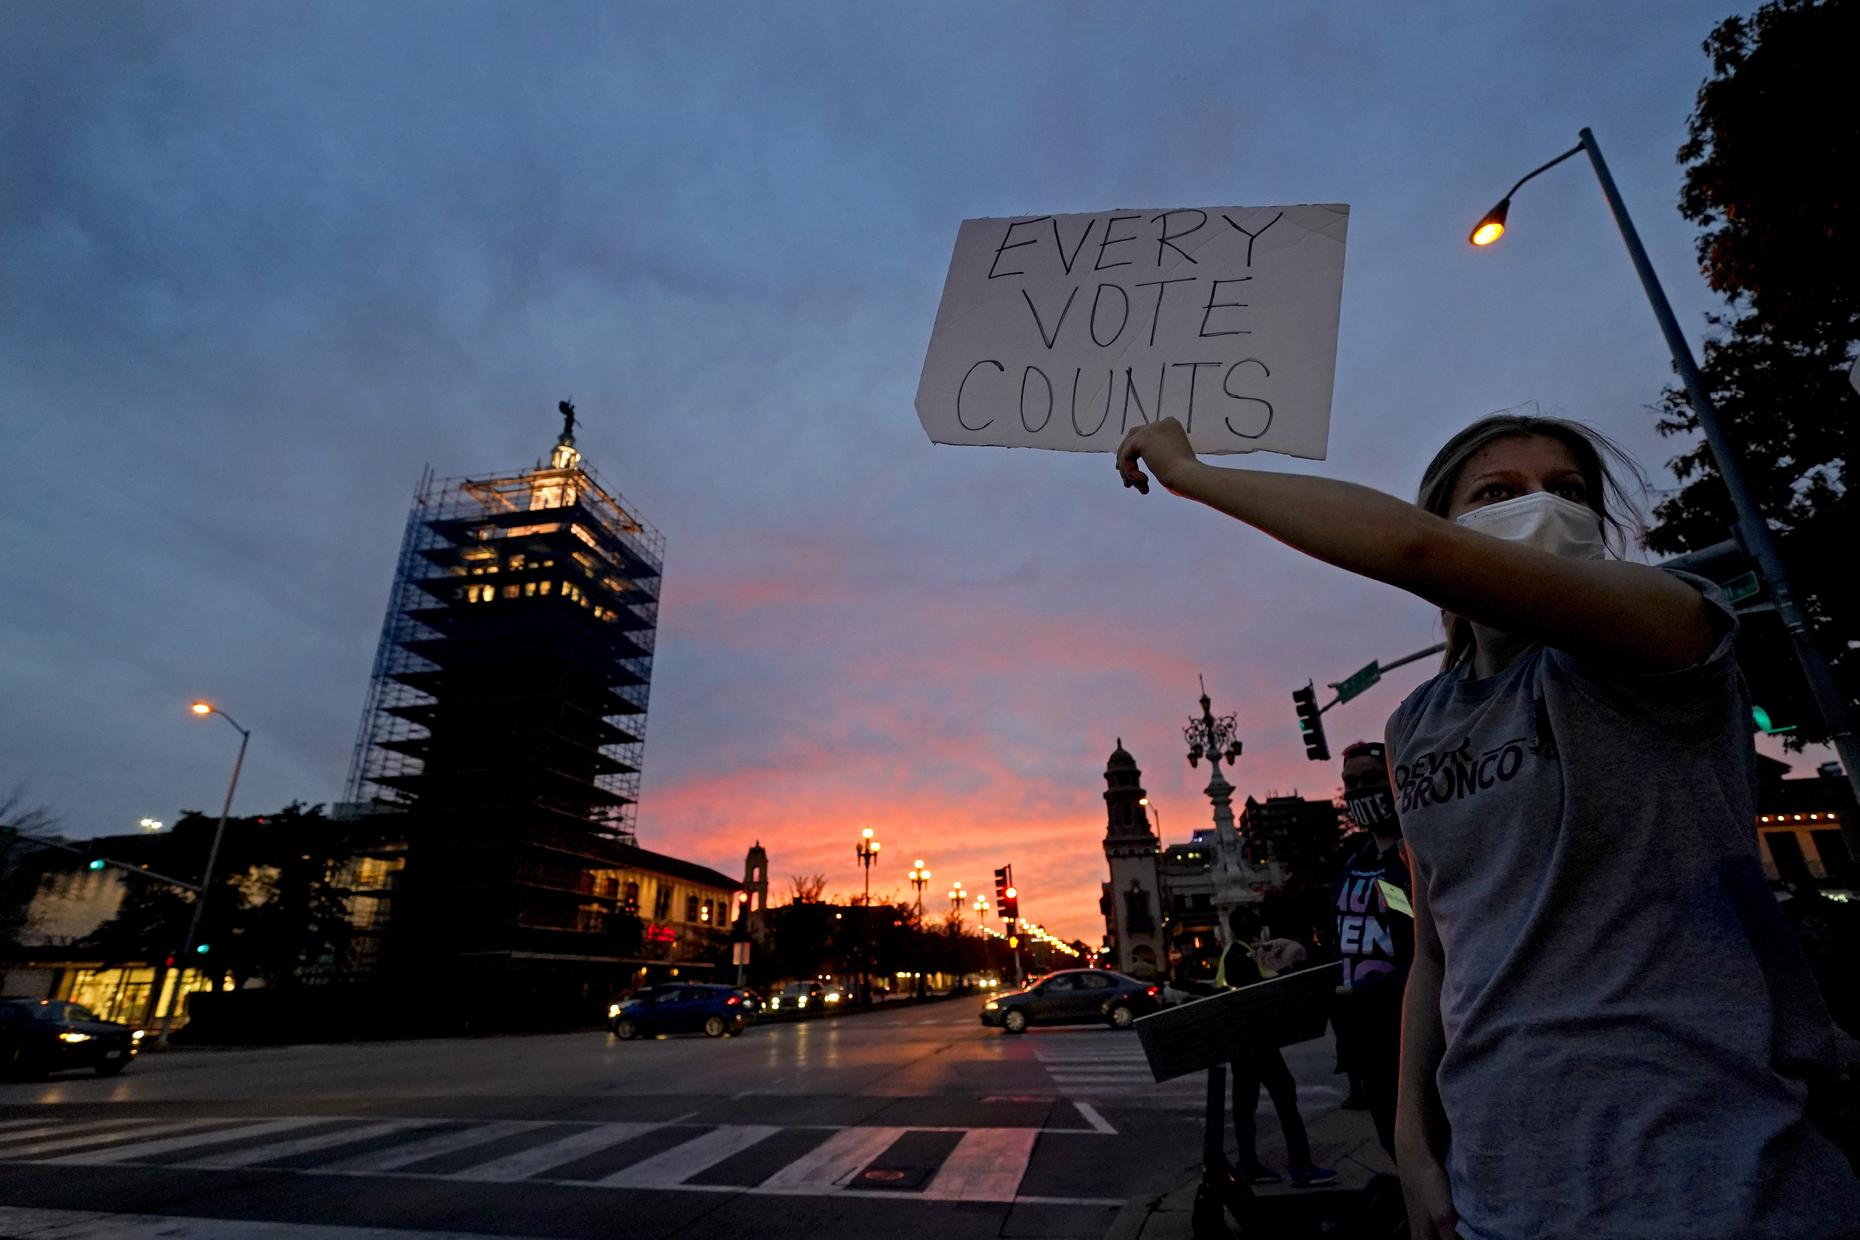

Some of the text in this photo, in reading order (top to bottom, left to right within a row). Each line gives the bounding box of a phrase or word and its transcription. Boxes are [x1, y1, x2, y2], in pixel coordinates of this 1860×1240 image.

[988, 209, 1283, 278] EVERY
[1022, 277, 1253, 349] VOTE
[957, 358, 1273, 439] COUNTS
